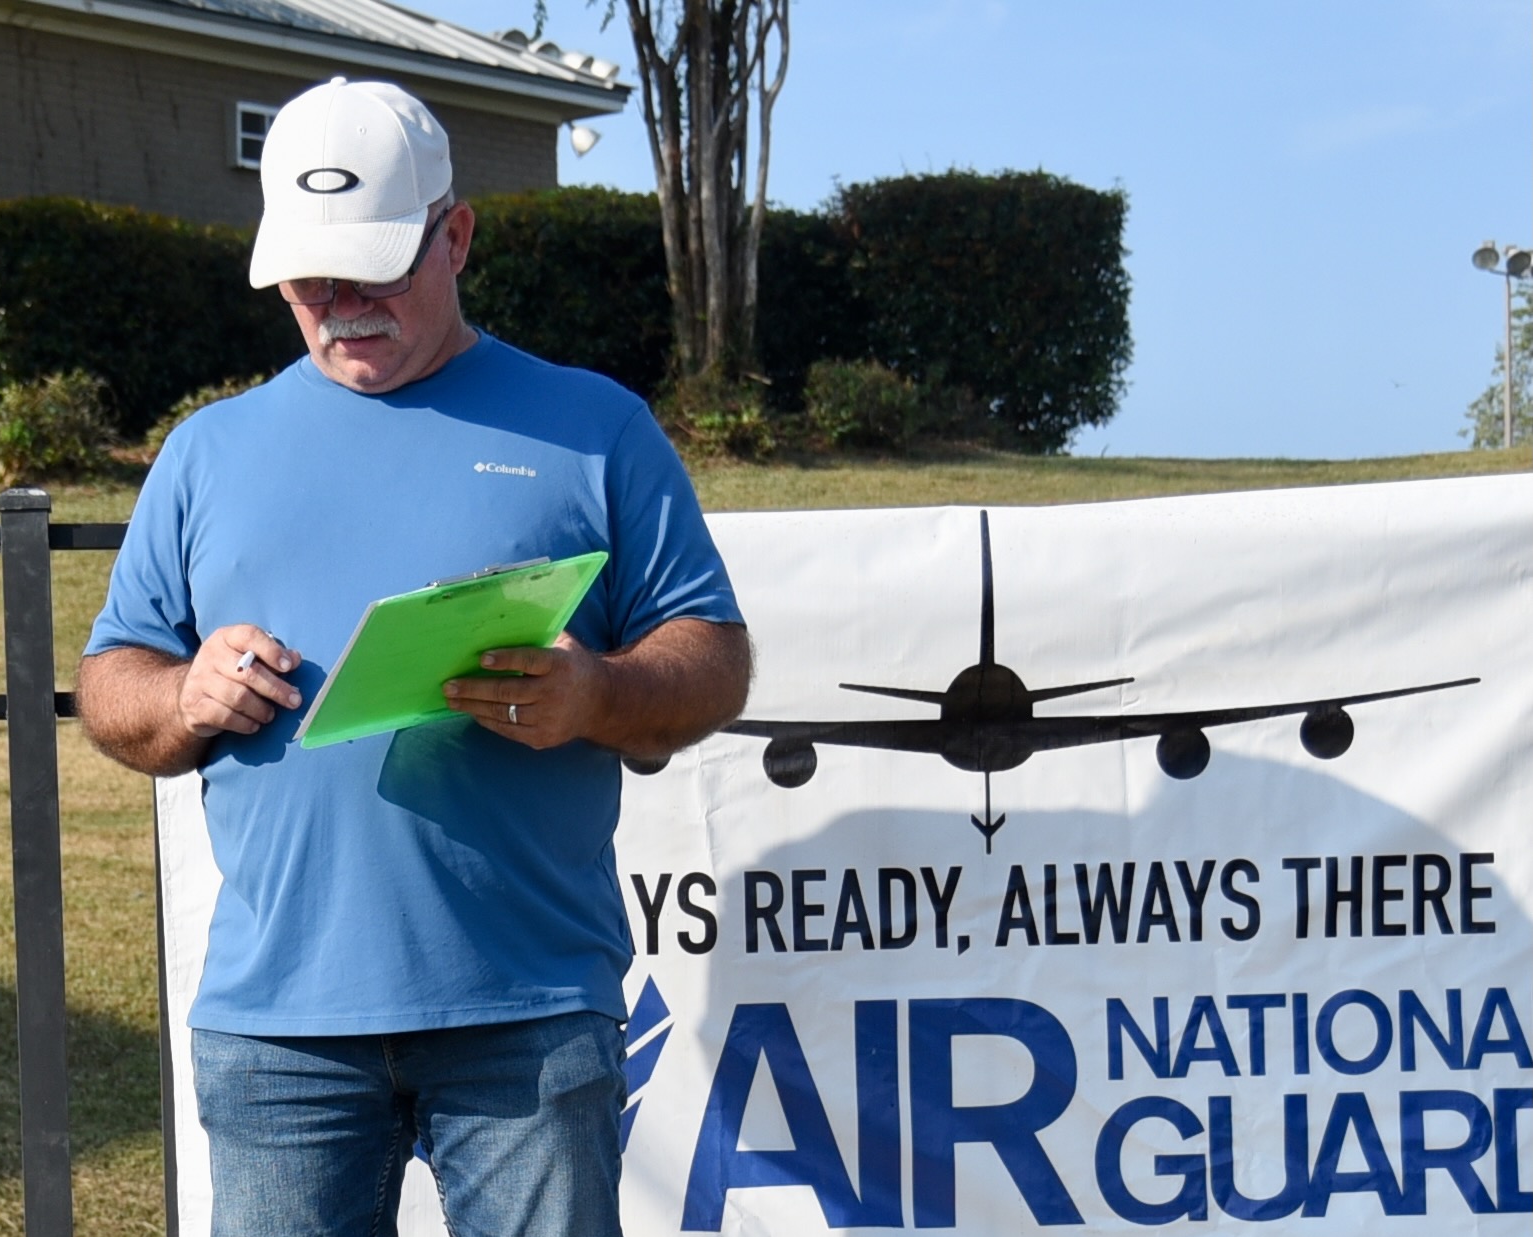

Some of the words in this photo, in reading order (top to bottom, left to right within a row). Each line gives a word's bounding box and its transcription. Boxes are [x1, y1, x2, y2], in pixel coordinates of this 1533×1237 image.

[486, 462, 537, 478] Columbia
[630, 870, 718, 956] YS
[743, 868, 970, 956] READY,
[994, 858, 1261, 947] ALWAYS
[1281, 851, 1497, 939] THERE
[679, 996, 1086, 1233] AIR
